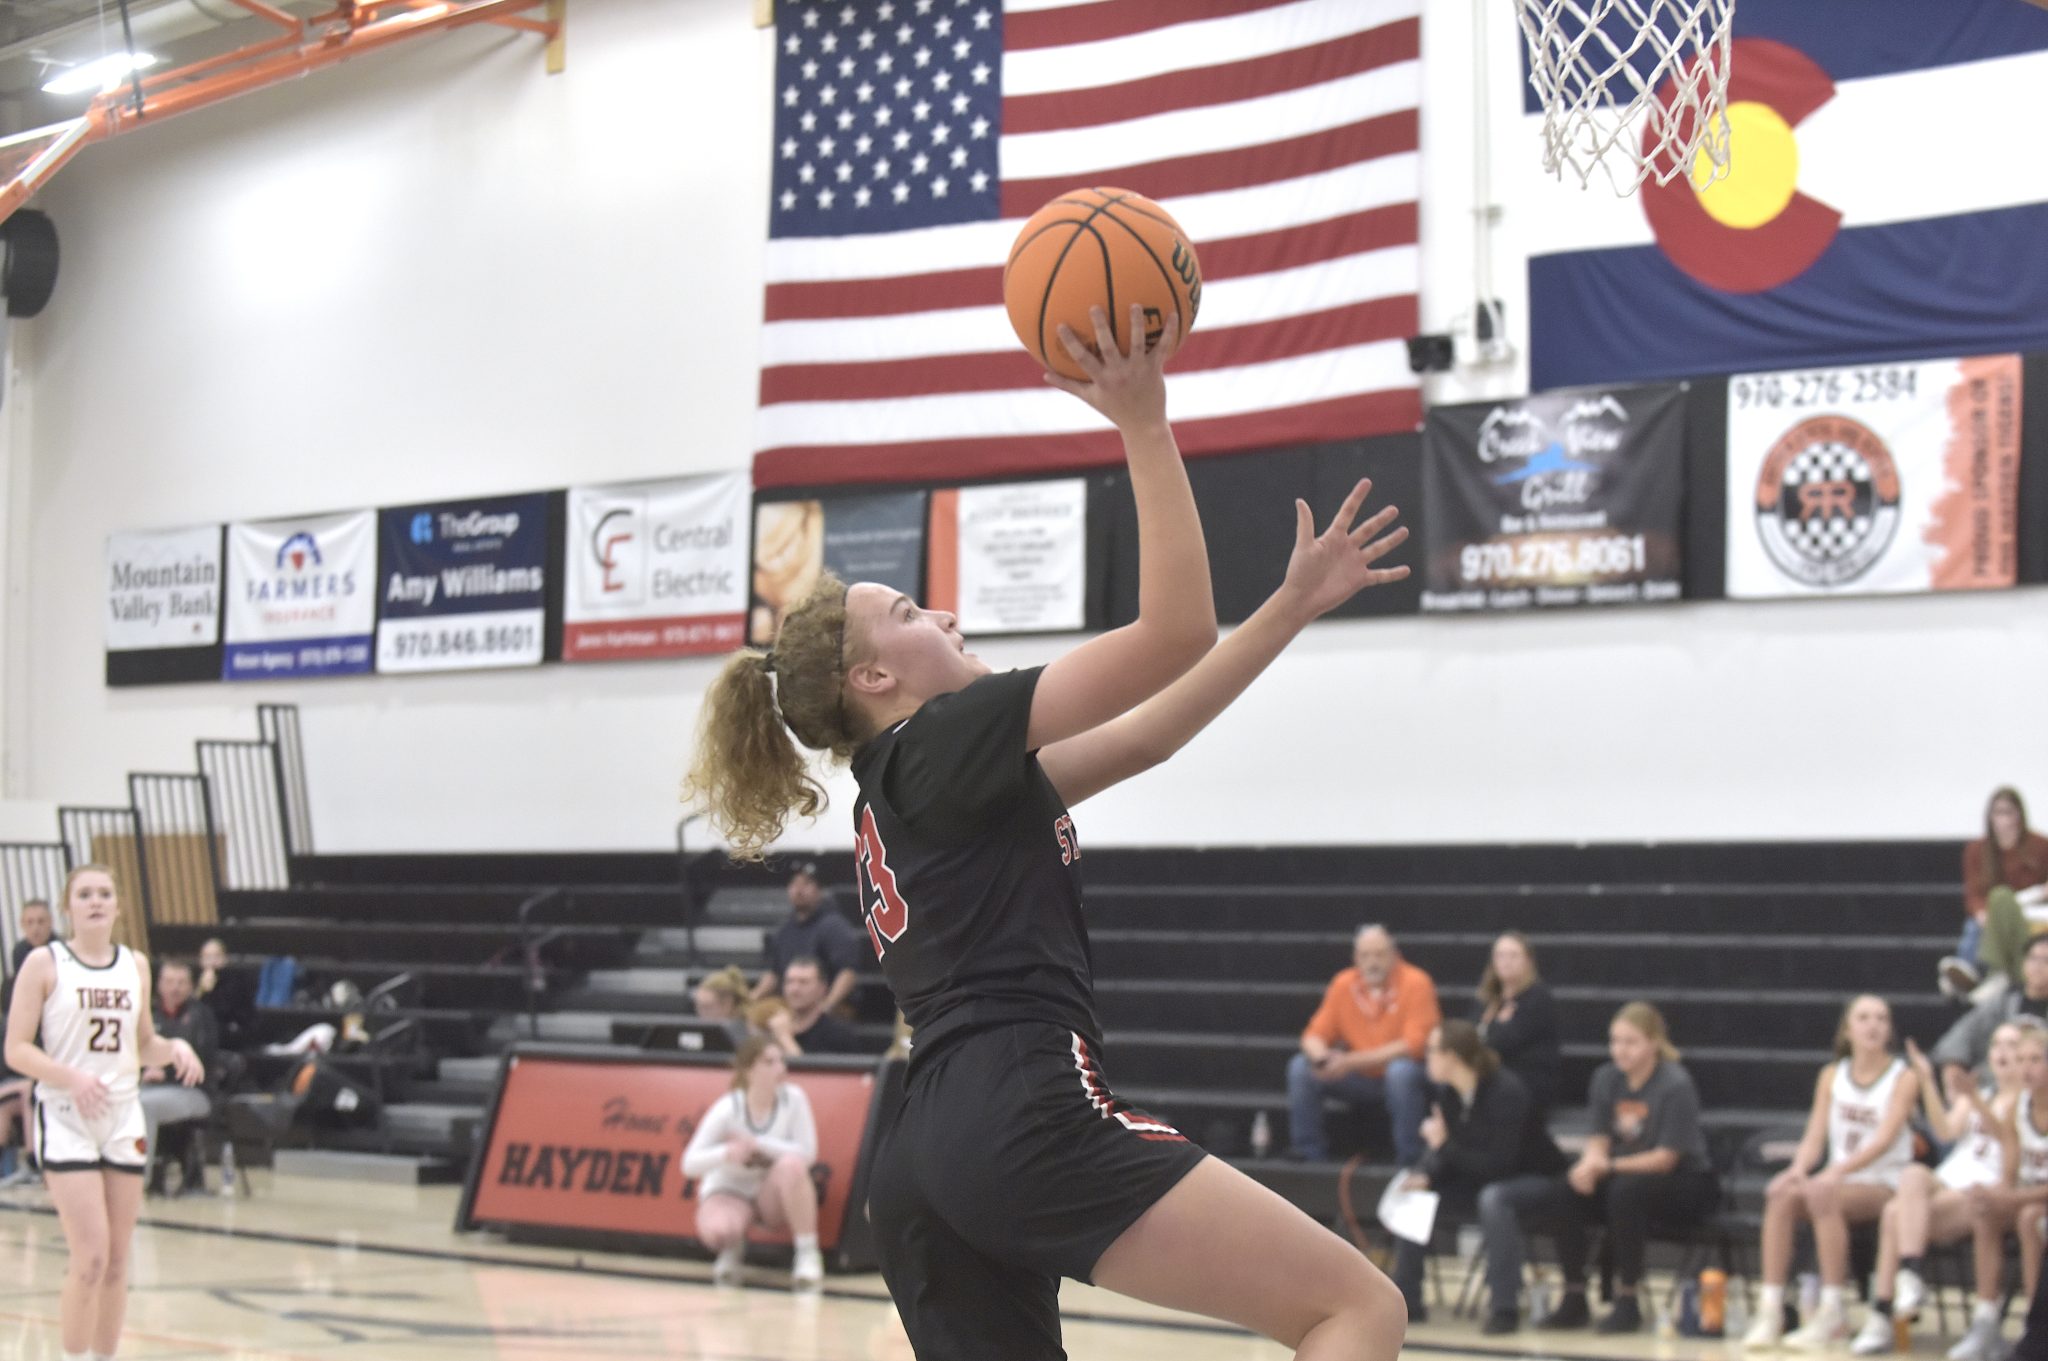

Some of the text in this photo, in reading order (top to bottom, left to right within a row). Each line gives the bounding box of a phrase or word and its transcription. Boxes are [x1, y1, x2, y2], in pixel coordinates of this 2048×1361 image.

[653, 517, 733, 553] Central
[111, 554, 215, 591] Mountain
[247, 571, 356, 603] FARMERS
[387, 563, 543, 607] Amy Williams
[653, 569, 734, 599] Electric
[110, 591, 216, 626] Valley Bank
[77, 987, 133, 1011] TIGERS
[88, 1018, 121, 1053] 23
[602, 1096, 669, 1134] Home
[499, 1142, 671, 1199] HAYDEN
